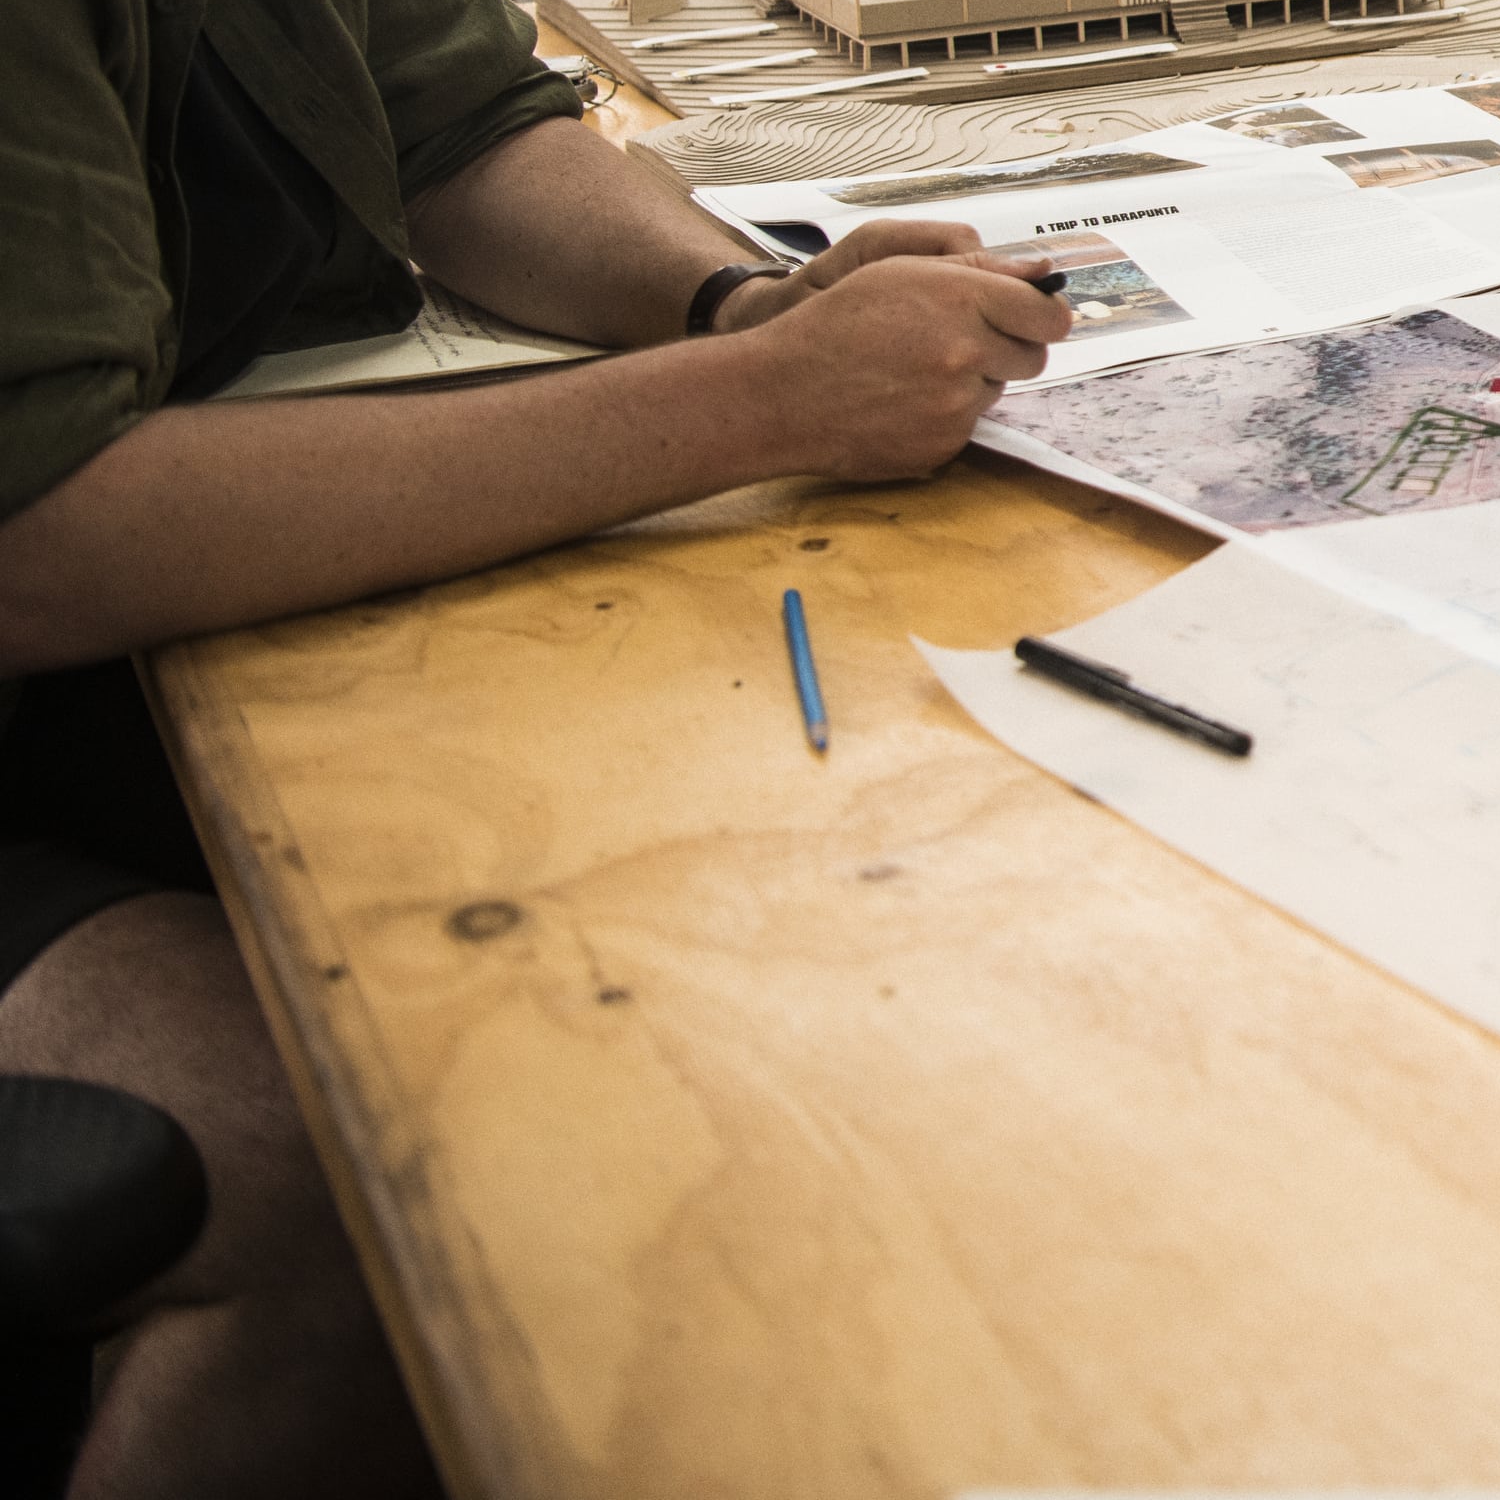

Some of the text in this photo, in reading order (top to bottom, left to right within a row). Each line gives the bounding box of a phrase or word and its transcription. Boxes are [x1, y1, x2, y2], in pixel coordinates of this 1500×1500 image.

[1035, 205, 1180, 234] A TRIP TO BARAPUNTA
